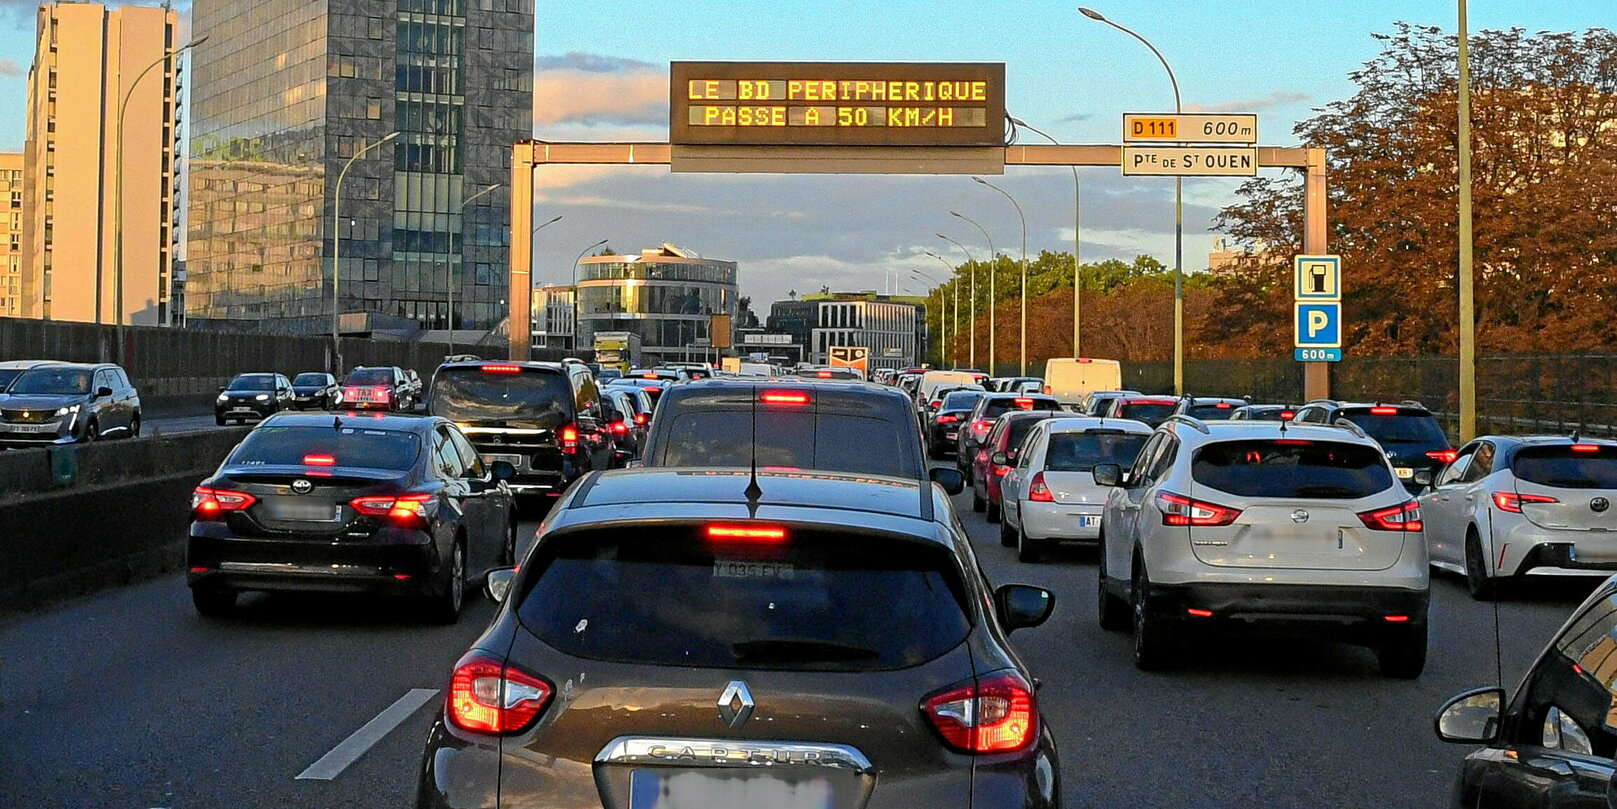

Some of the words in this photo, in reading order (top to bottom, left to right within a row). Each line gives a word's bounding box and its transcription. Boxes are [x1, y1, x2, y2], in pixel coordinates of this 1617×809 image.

[688, 80, 719, 99] LE
[738, 81, 769, 99] BD
[788, 81, 987, 100] PERIPHERIQUE
[704, 106, 786, 126] PASSE
[804, 107, 819, 126] A
[838, 107, 867, 126] 50
[888, 107, 953, 126] KM/H
[1133, 121, 1144, 135] D
[1149, 121, 1175, 135] 111
[1162, 159, 1176, 168] DE
[1205, 155, 1250, 168] OUEN
[1308, 310, 1328, 338] P
